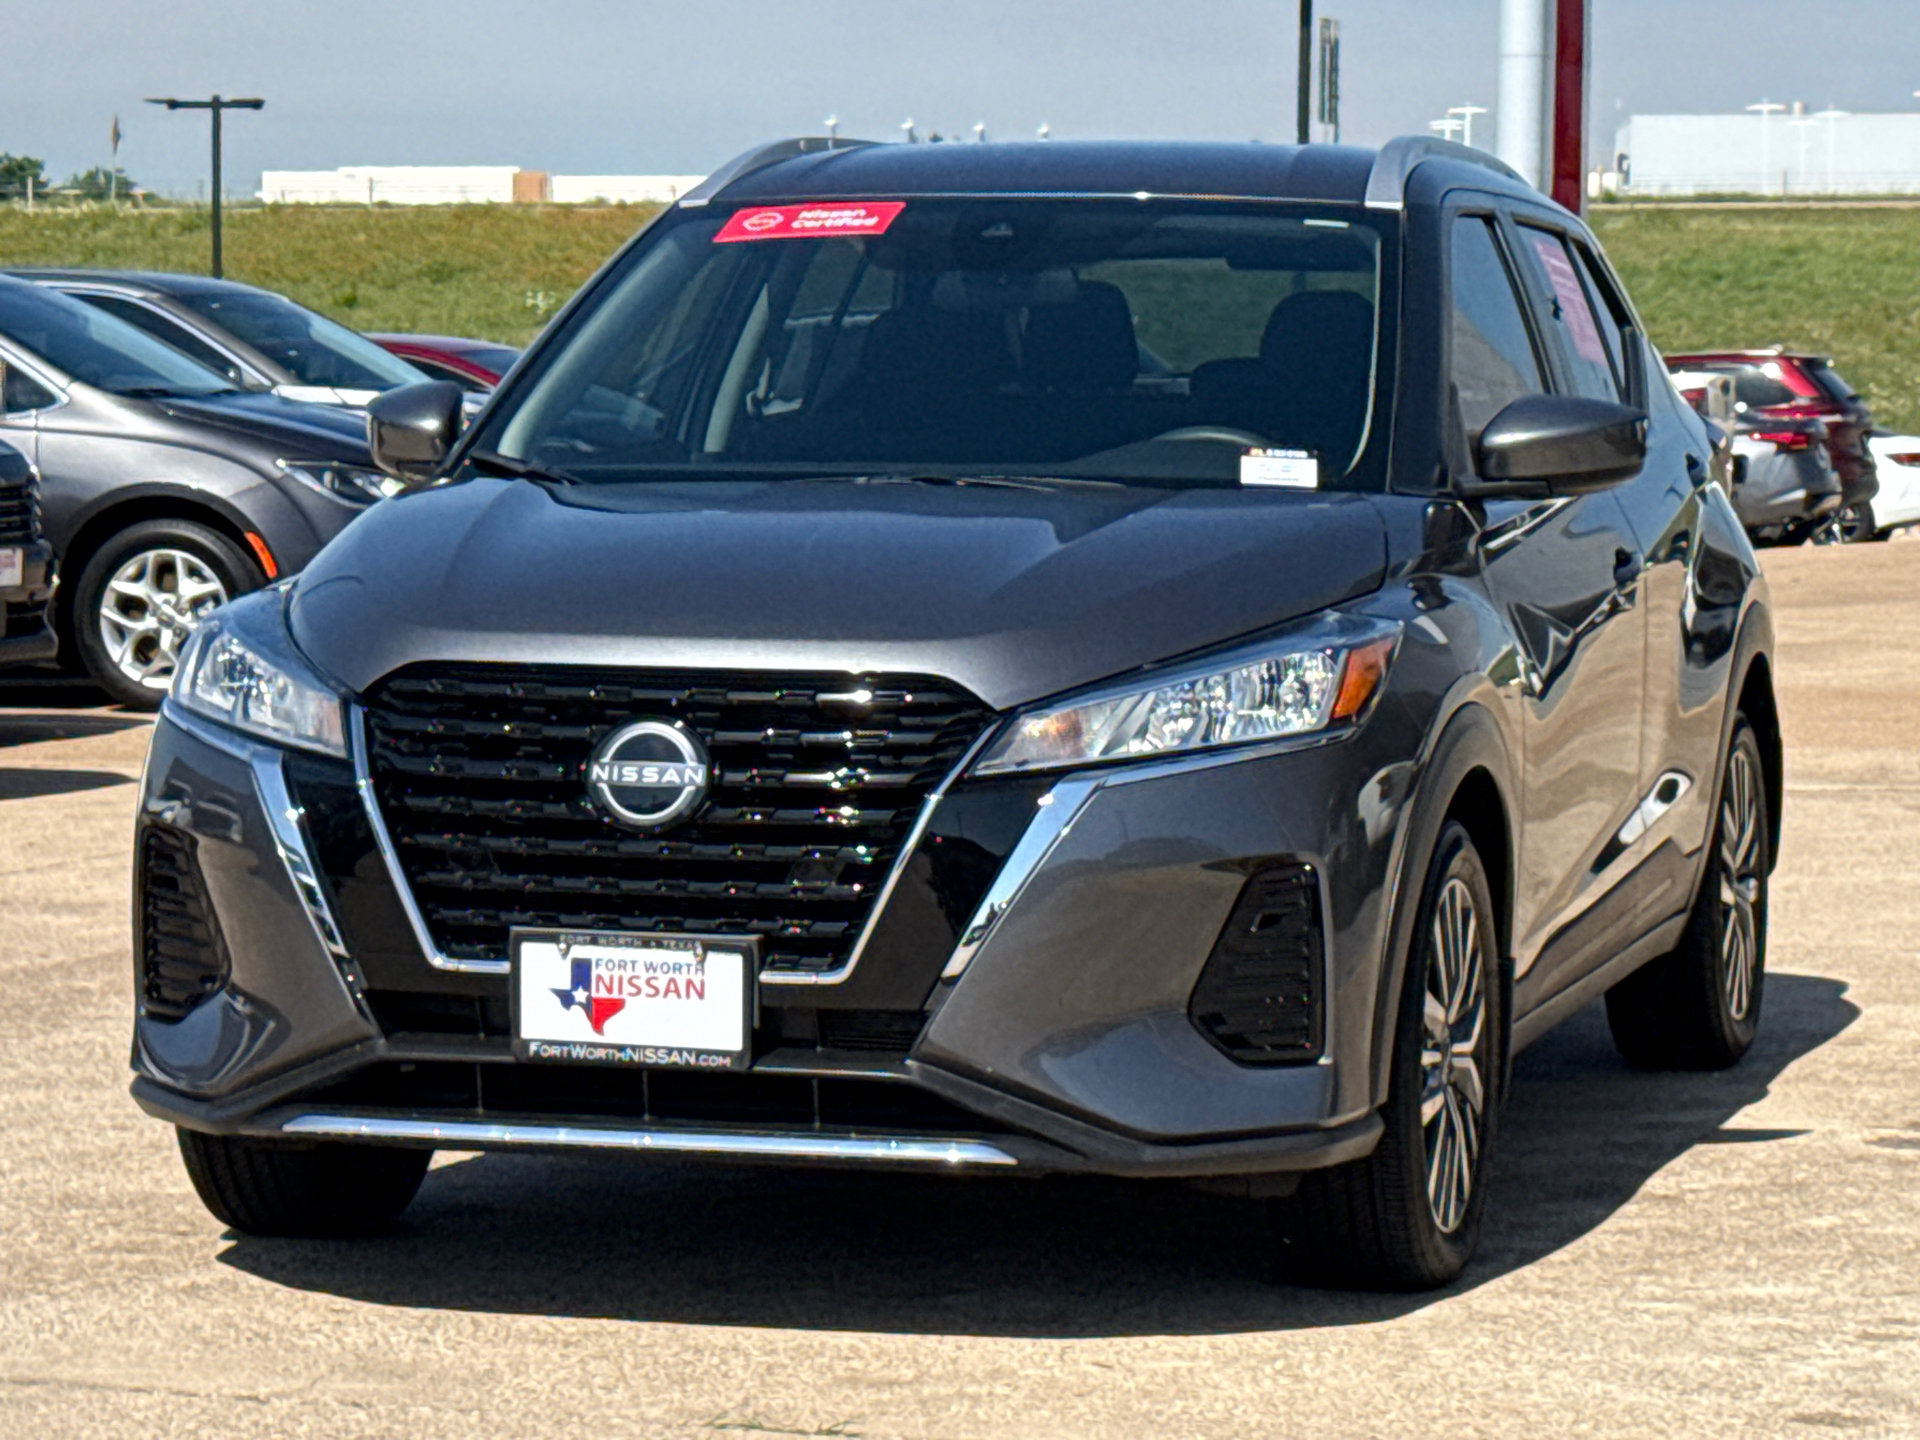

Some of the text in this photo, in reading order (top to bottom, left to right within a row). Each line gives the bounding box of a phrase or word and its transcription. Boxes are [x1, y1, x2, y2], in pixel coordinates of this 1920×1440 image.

[791, 215, 879, 228] Certified
[798, 208, 867, 219] Nissan
[591, 764, 703, 784] NISSAN
[559, 934, 591, 944] FORT
[597, 936, 643, 947] WORTH
[594, 958, 705, 977] FORT WORTH
[594, 974, 705, 1000] NISSAN
